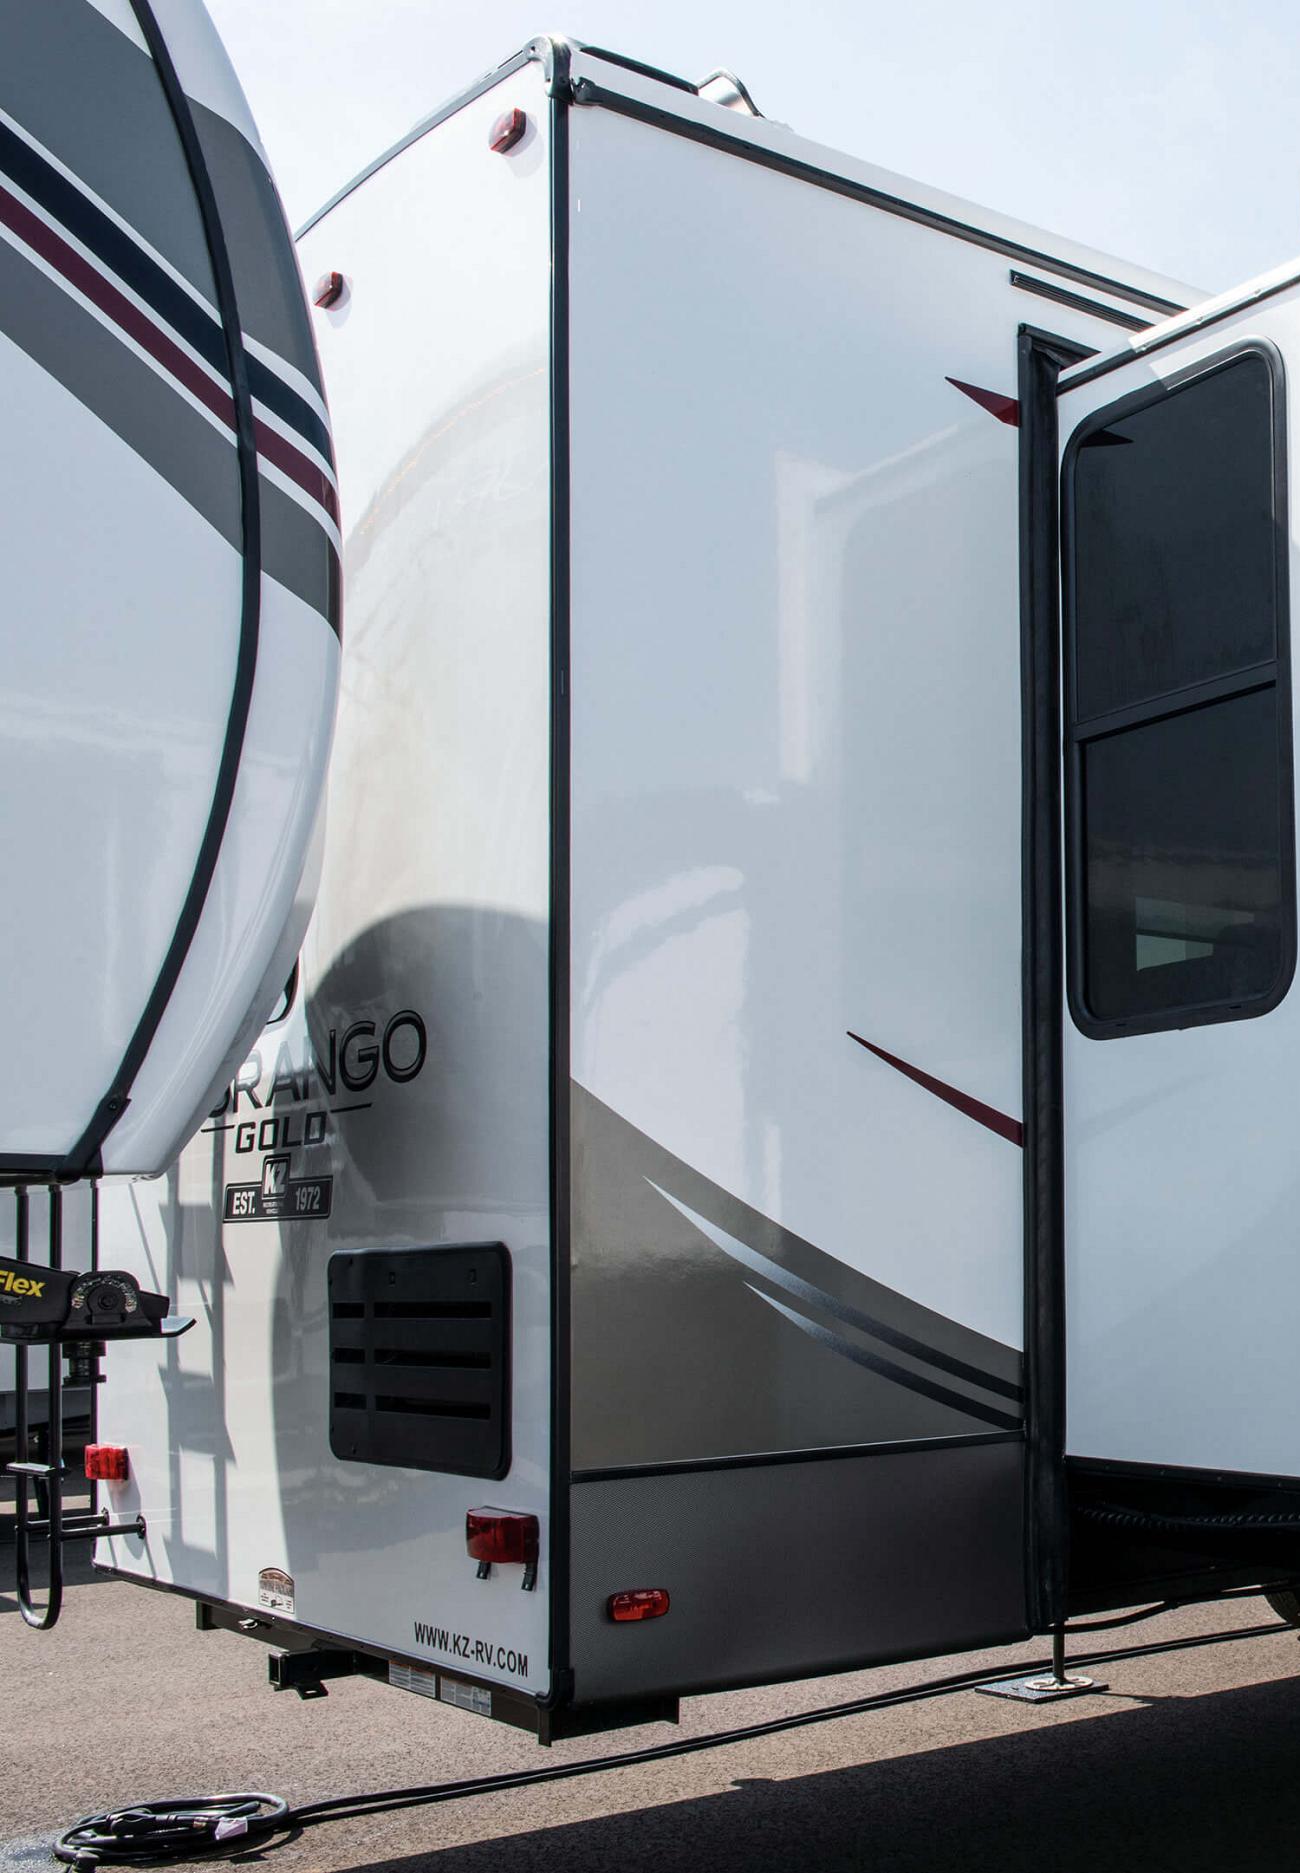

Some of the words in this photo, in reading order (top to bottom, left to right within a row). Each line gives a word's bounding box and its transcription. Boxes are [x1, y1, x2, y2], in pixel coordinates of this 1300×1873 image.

[207, 1009, 427, 1118] RANGO
[235, 1111, 327, 1154] GOLD
[263, 1161, 287, 1195] KZ
[232, 1191, 256, 1215] EST.
[295, 1186, 321, 1211] 1972
[414, 1621, 528, 1678] WWW.KZ-RV.COM
